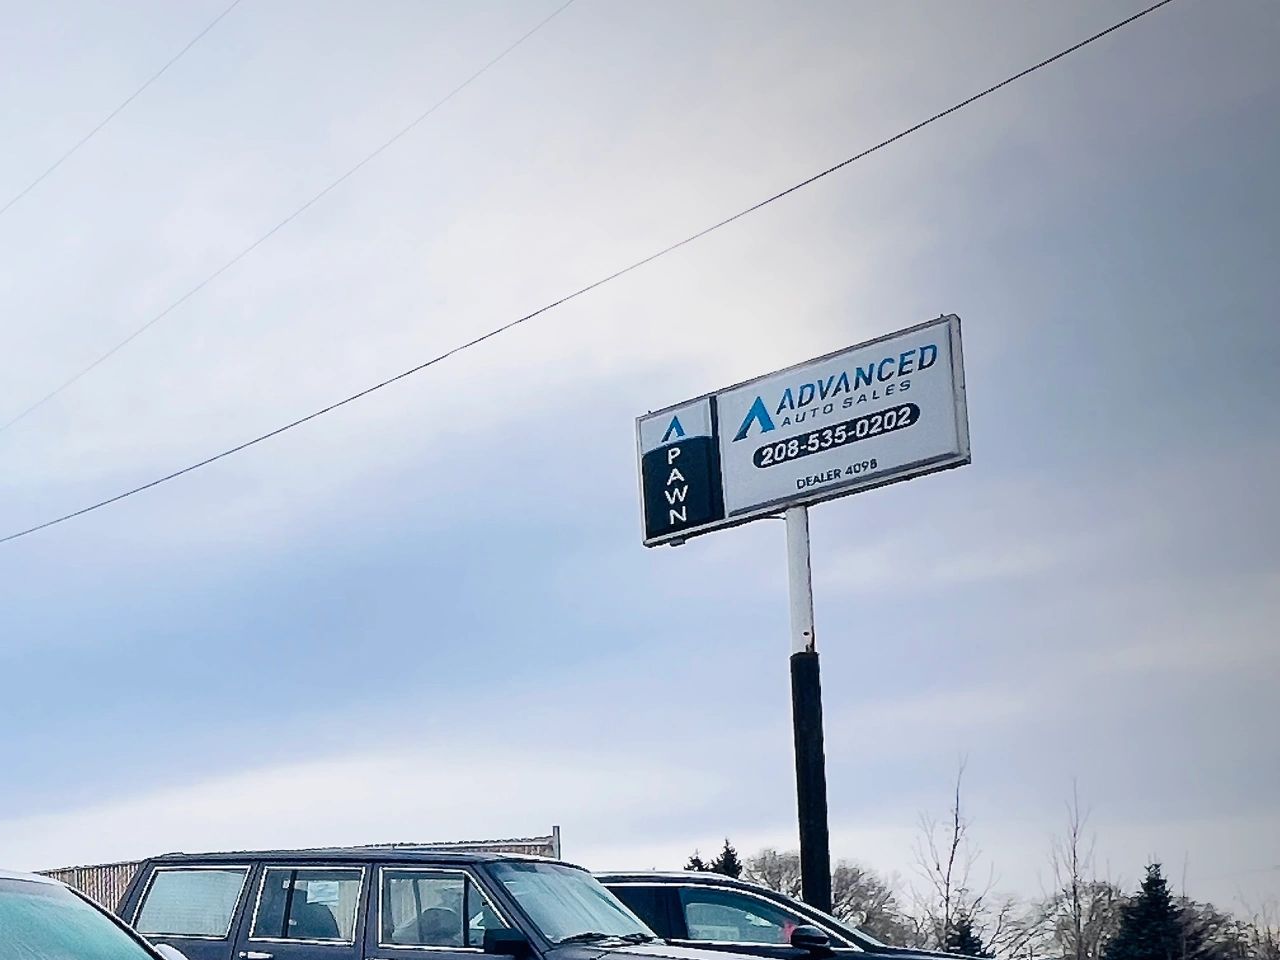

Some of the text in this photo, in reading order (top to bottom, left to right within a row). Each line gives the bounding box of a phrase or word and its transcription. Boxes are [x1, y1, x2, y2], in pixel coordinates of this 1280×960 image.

[776, 344, 938, 415] ADVANCED
[781, 379, 911, 428] AUTO SALES
[760, 407, 911, 466] 208-535-0202
[665, 447, 689, 525] PAWN
[796, 459, 878, 490] DEALER 4098
